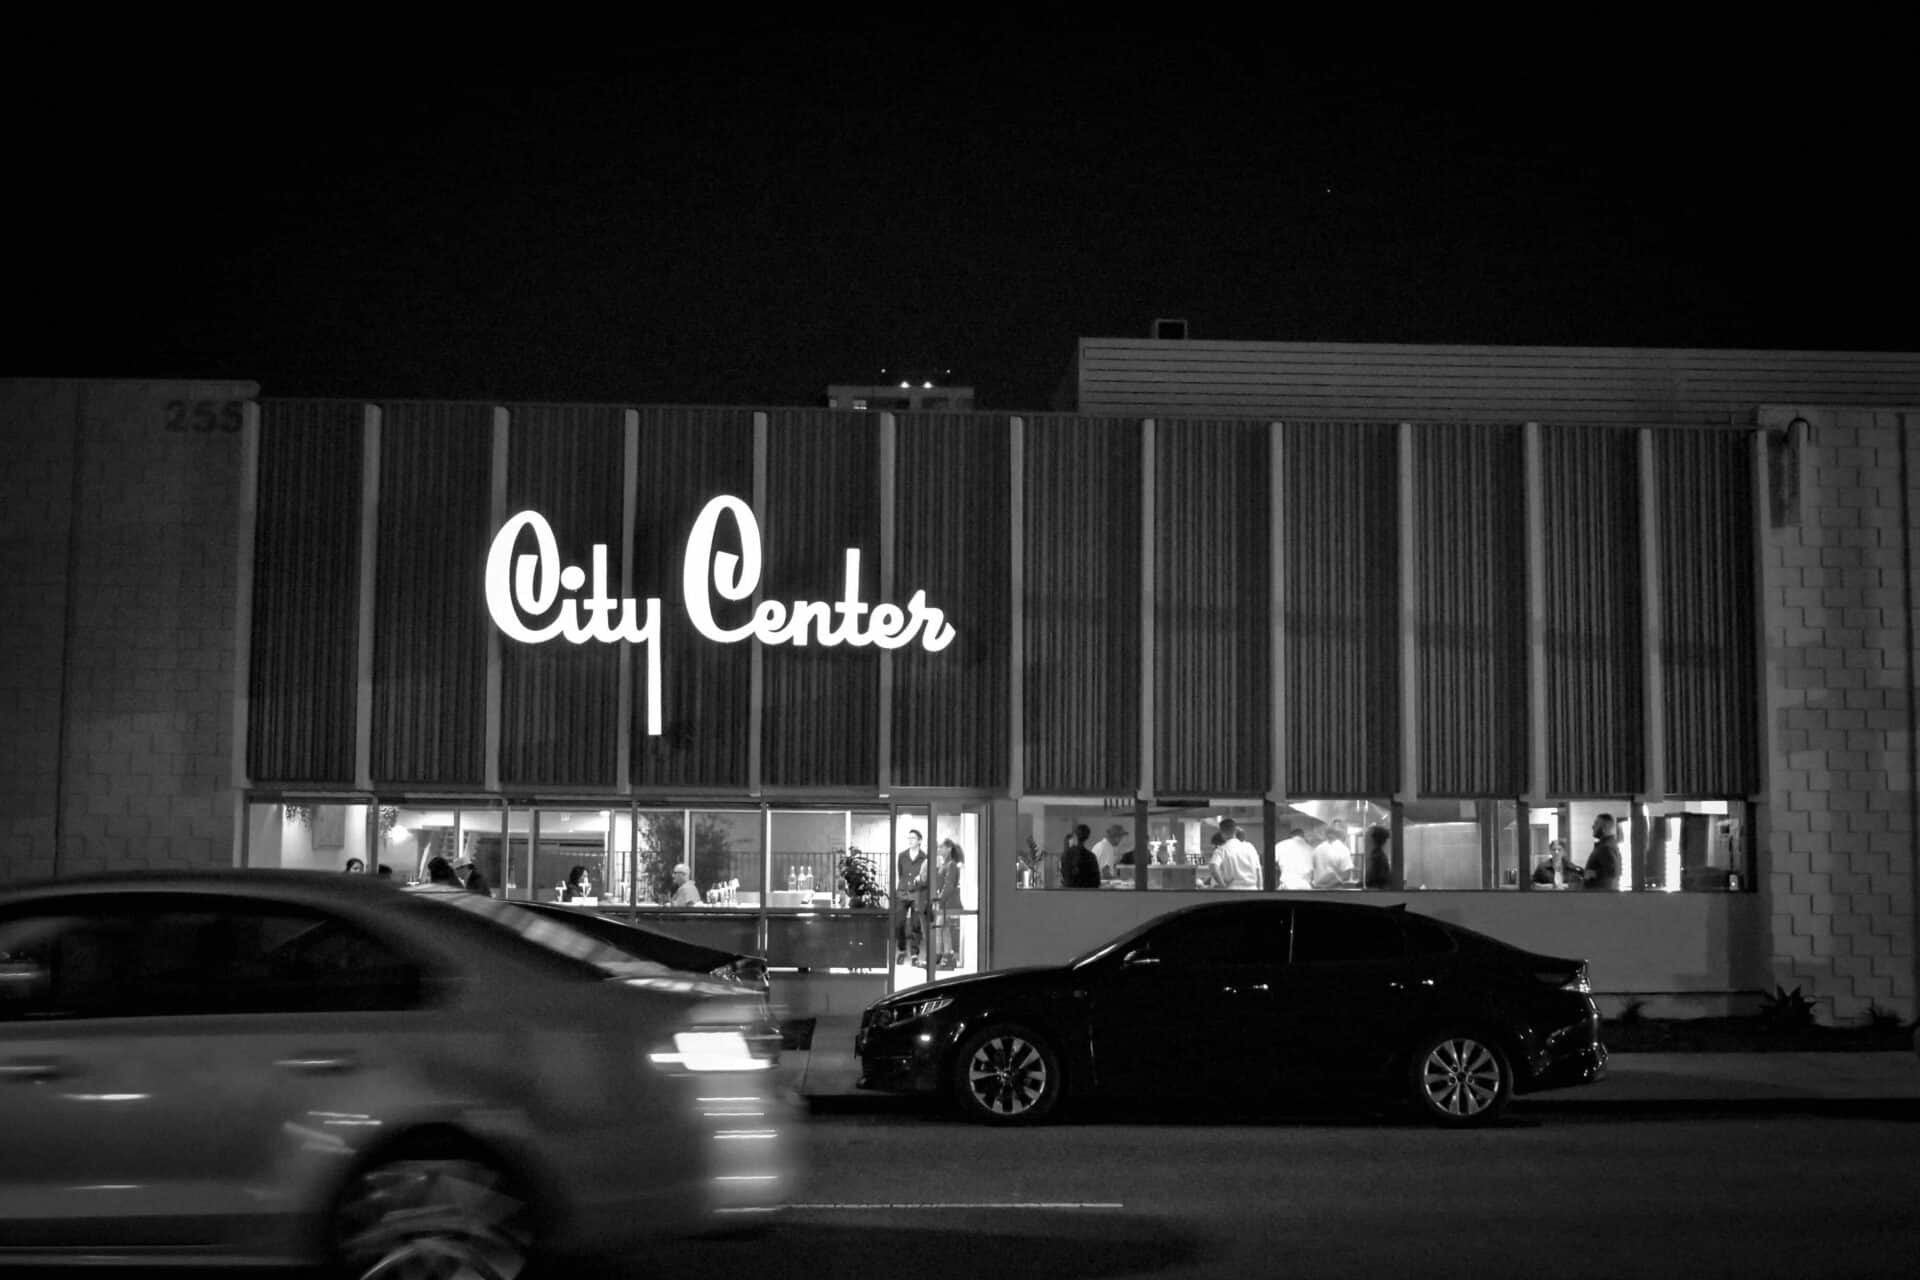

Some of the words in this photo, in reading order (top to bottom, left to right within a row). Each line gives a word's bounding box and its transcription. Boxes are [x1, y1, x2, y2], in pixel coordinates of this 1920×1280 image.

[165, 400, 242, 433] 255
[485, 510, 662, 736] City
[683, 494, 956, 652] Center
